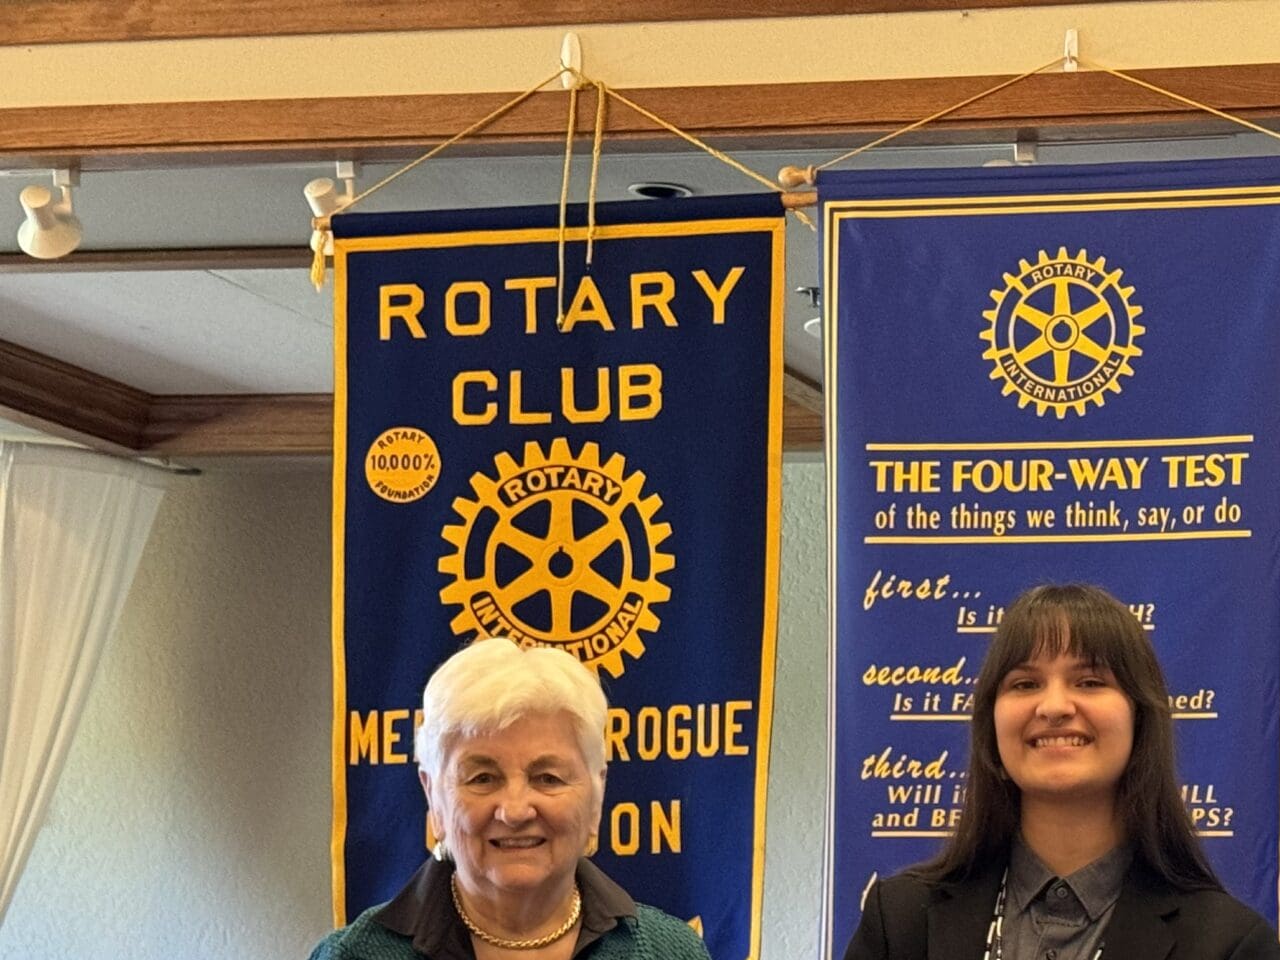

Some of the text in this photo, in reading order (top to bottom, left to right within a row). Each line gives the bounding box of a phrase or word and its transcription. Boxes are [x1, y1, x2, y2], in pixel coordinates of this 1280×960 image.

[1031, 264, 1096, 283] ROTARY
[379, 266, 746, 340] ROTARY
[452, 363, 663, 425] CLUB
[1003, 357, 1121, 401] INTERNATIONAL
[377, 431, 425, 449] ROTARY
[371, 453, 435, 472] 10,000%
[869, 453, 1250, 494] THE FOUR-WAY TEST
[375, 474, 434, 500] FOUNDATION
[503, 467, 621, 503] ROTARY
[875, 496, 1242, 536] of the things we think, say, or do
[863, 570, 981, 610] first...
[957, 604, 1005, 626] Is it
[893, 693, 914, 712] Is
[923, 692, 942, 712] it
[606, 701, 753, 762] ROGUE
[888, 785, 942, 804] Will
[872, 807, 920, 828] and
